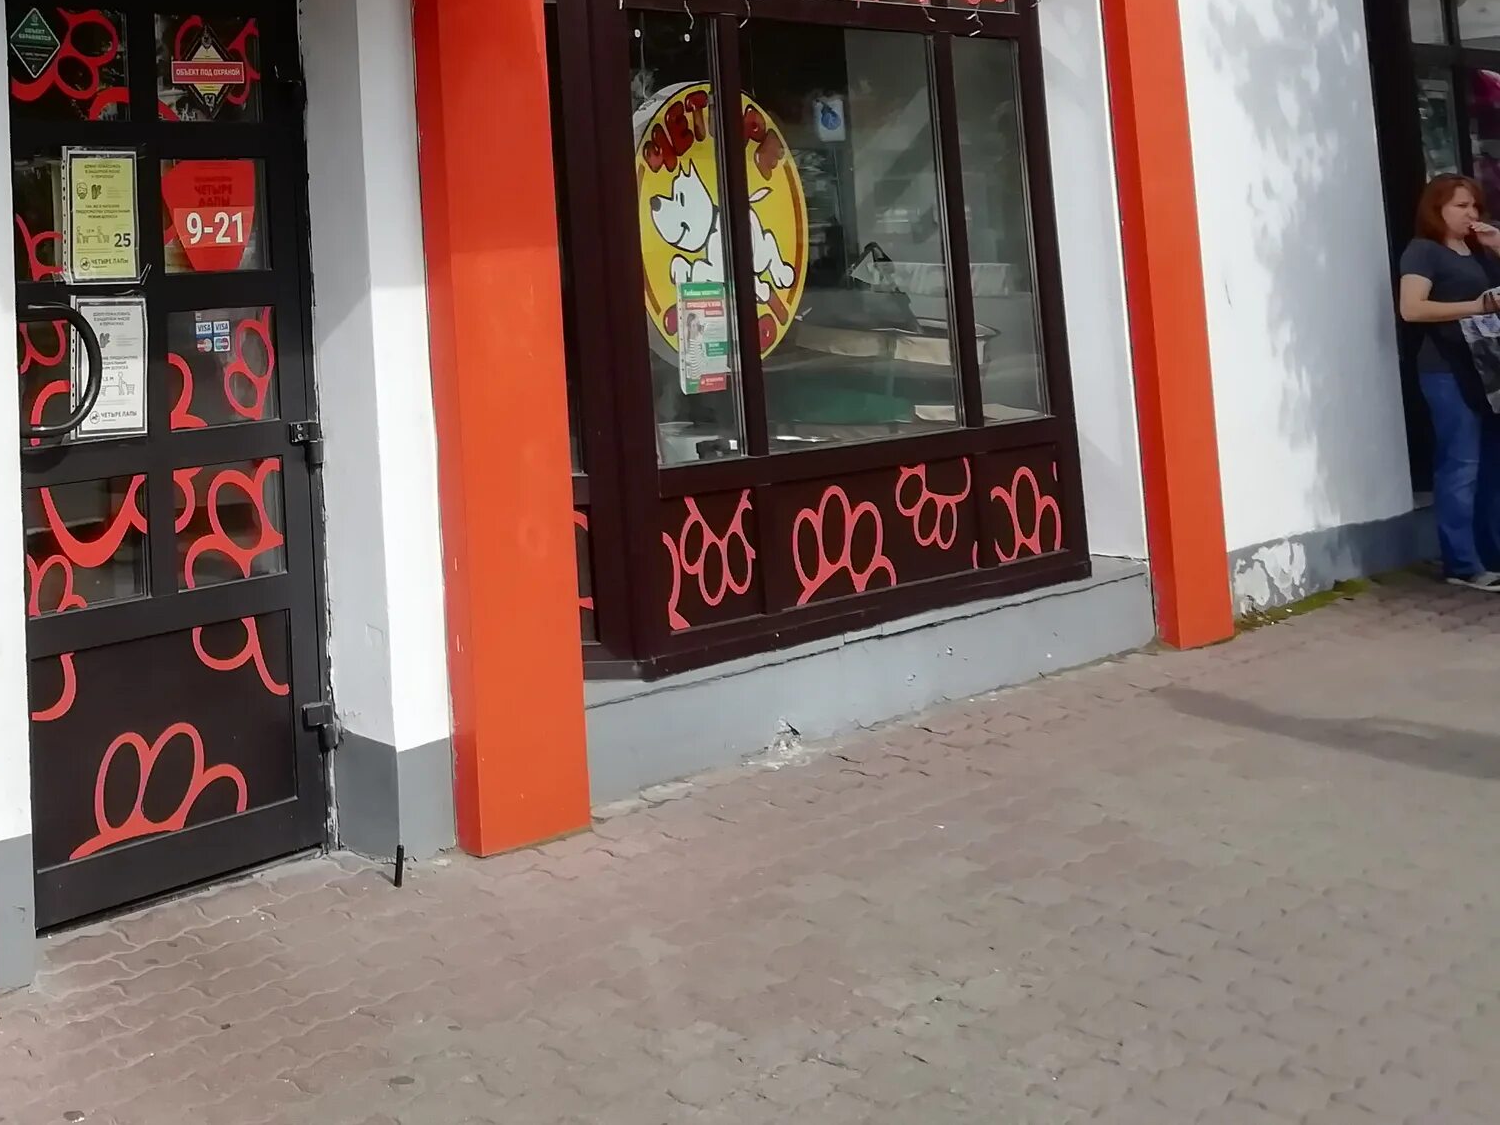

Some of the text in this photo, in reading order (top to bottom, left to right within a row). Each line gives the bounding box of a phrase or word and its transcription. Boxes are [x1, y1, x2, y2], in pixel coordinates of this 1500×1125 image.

[643, 90, 786, 181] ЧЕТРЕ
[186, 211, 244, 245] 9-21
[113, 232, 131, 248] 25
[198, 324, 211, 332] VISA
[215, 323, 229, 331] VISA
